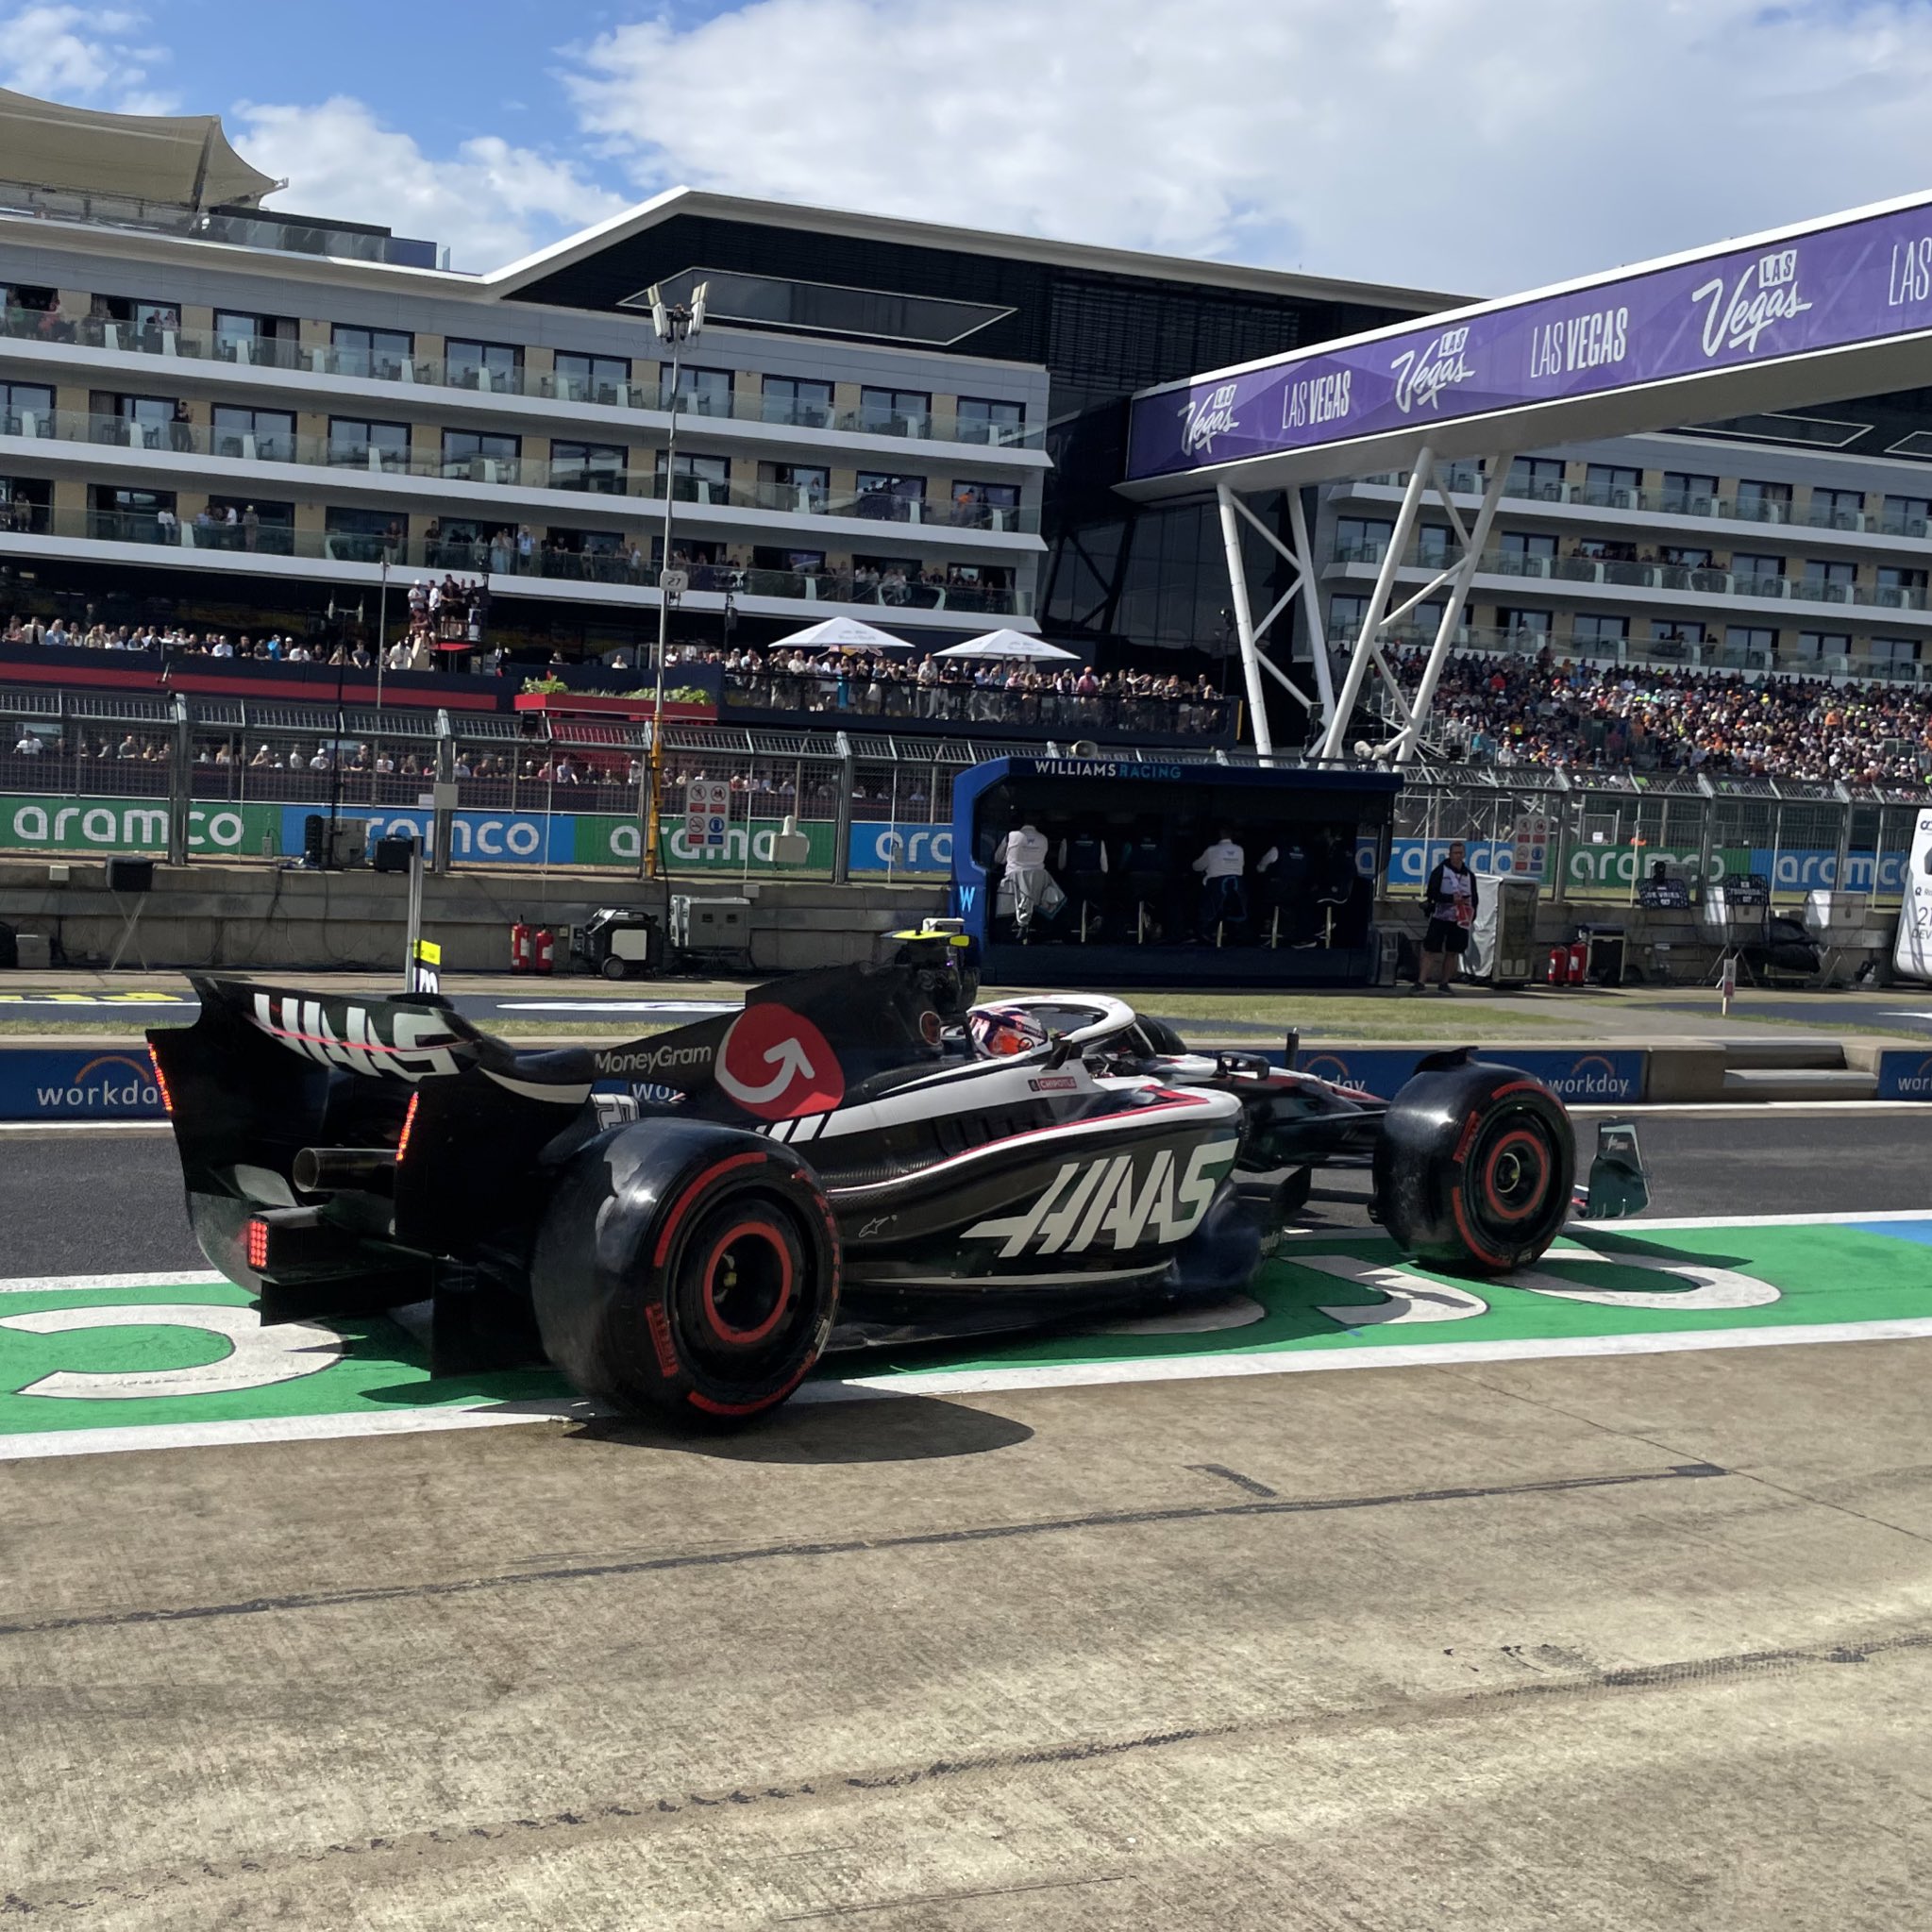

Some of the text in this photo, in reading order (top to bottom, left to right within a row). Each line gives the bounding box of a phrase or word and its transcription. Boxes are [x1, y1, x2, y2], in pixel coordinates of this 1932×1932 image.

[1761, 251, 1795, 285] LAS
[1889, 237, 1932, 306] LAS
[1692, 265, 1812, 357] Vegas
[1440, 328, 1468, 355] LAS
[1531, 308, 1628, 378] LAS VEGAS
[1390, 339, 1475, 413] Vegas
[1282, 370, 1351, 429] LAS VEGAS
[1178, 393, 1239, 456] Vegas
[1034, 761, 1181, 779] WILLIAMS RACING
[960, 885, 976, 913] W
[595, 1046, 712, 1074] MoneyGram
[37, 1080, 159, 1105] workda
[1549, 1073, 1630, 1097] workday
[960, 1138, 1239, 1258] HAAS
